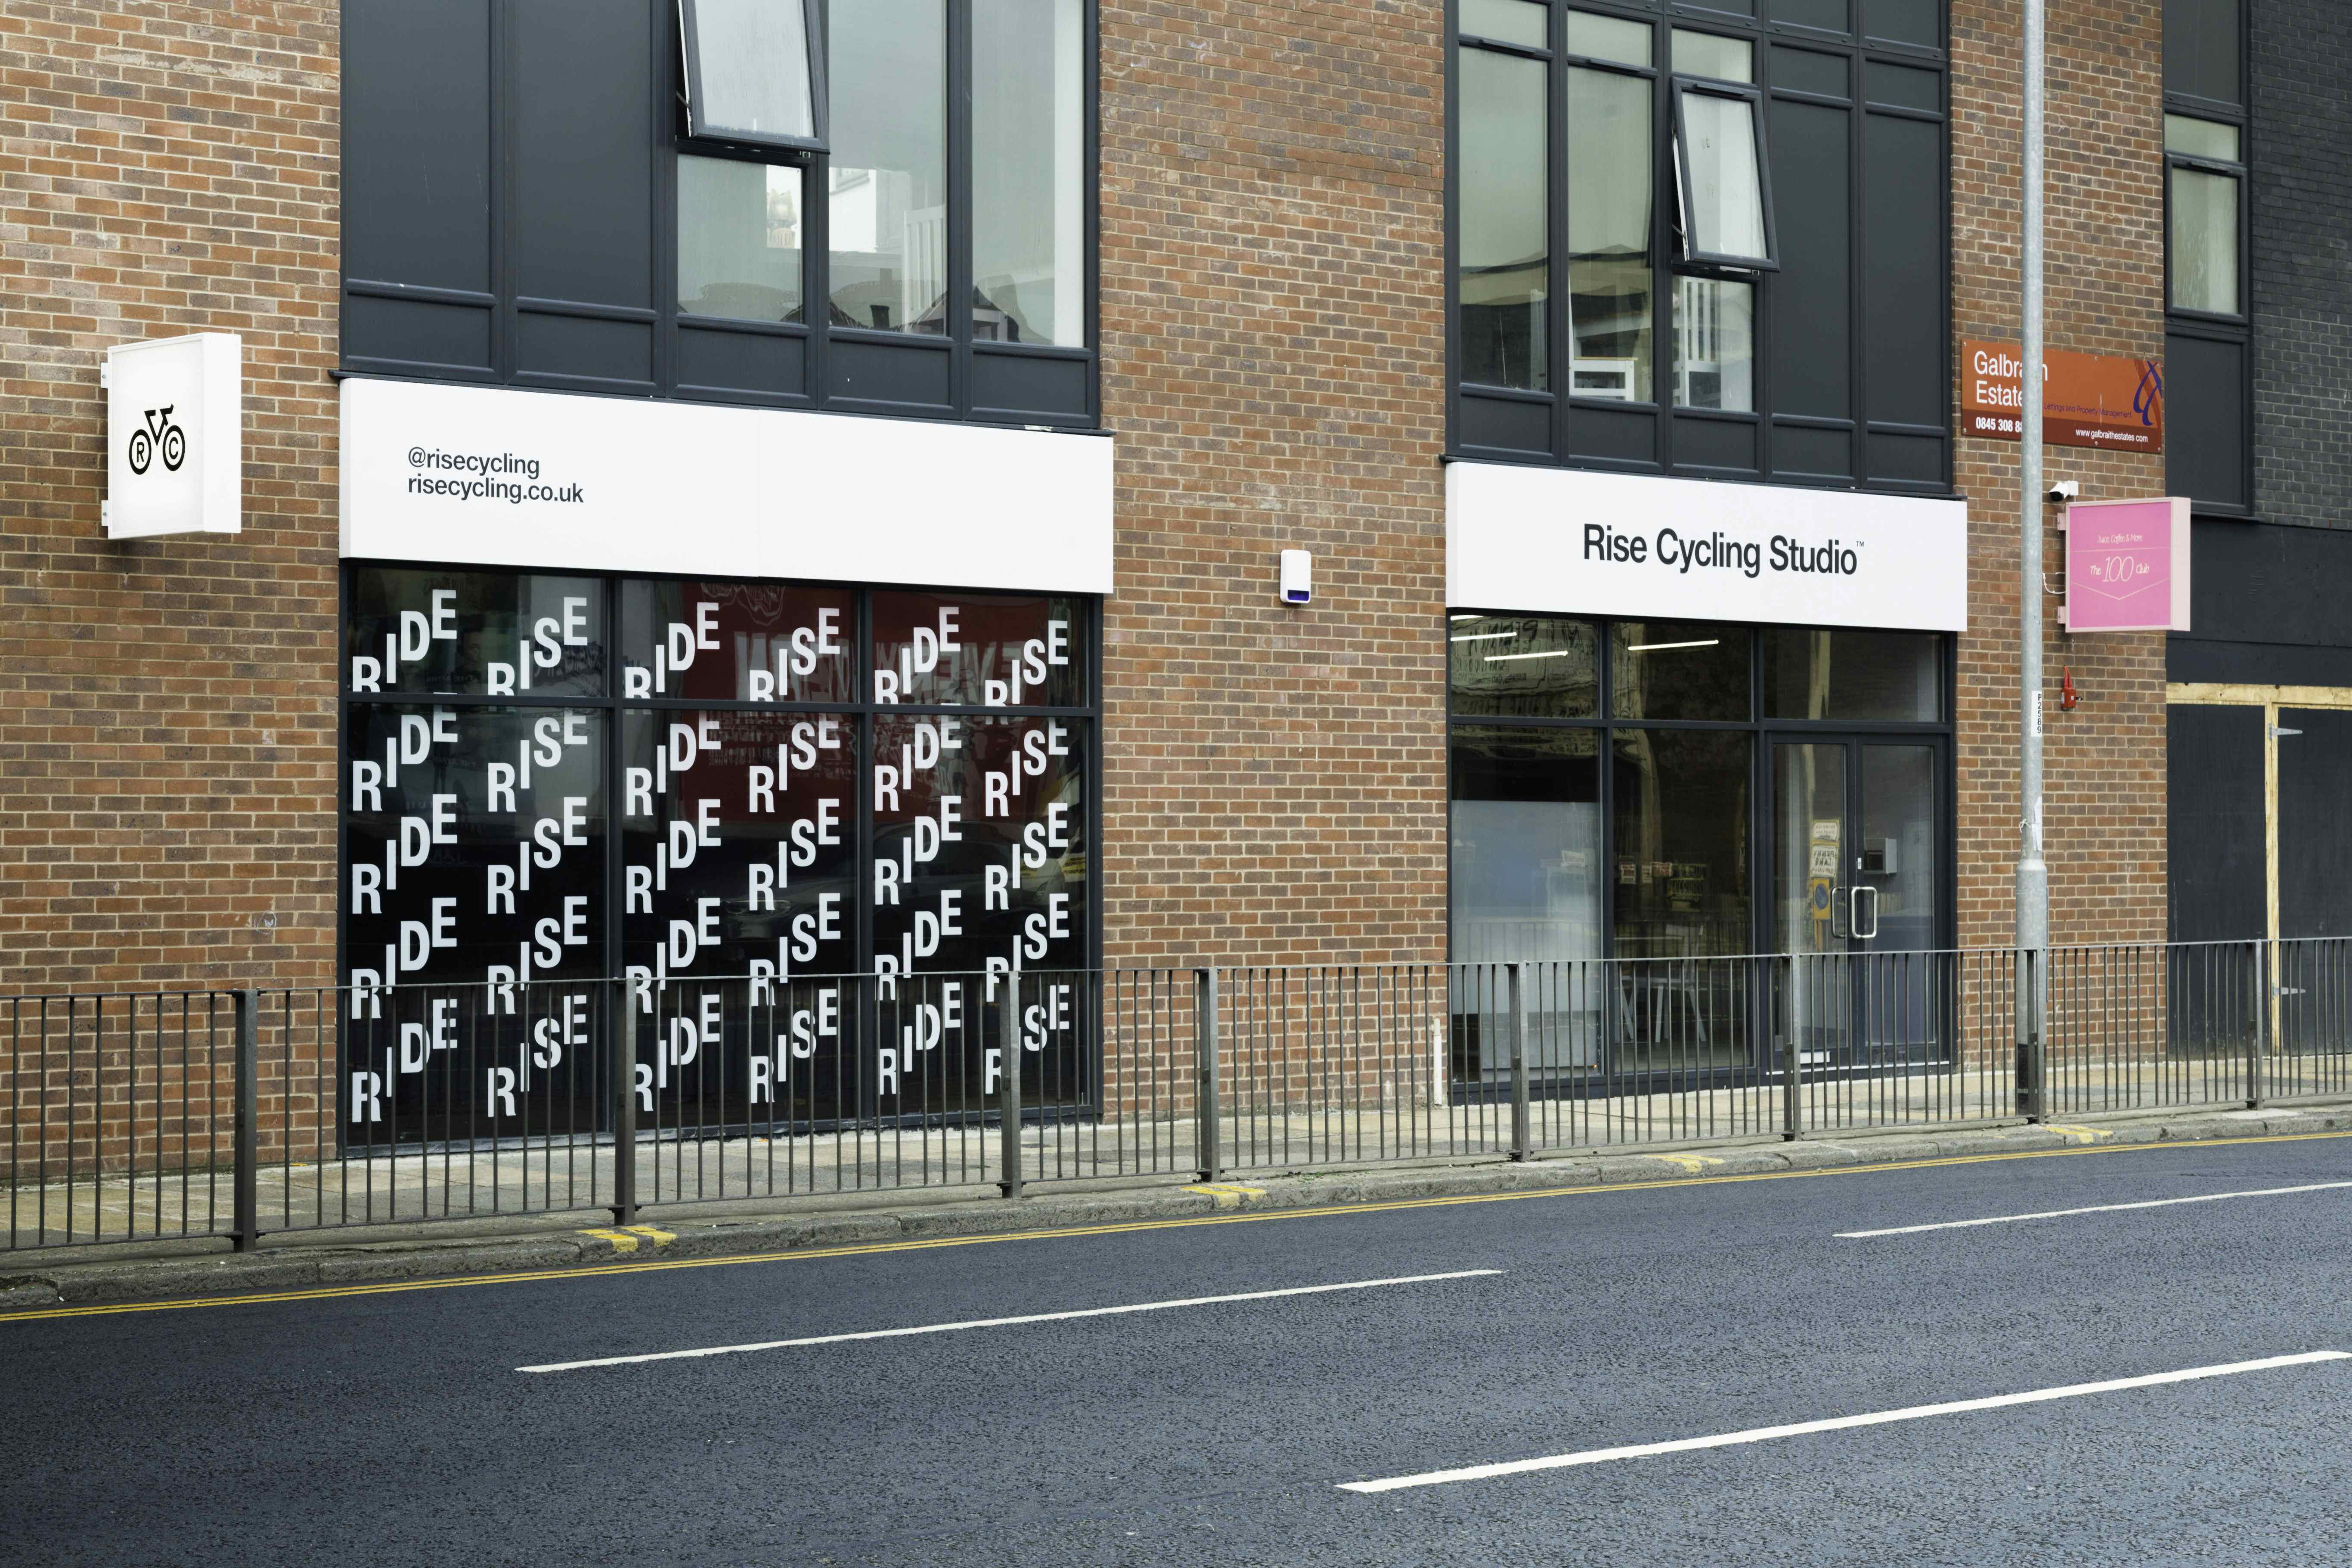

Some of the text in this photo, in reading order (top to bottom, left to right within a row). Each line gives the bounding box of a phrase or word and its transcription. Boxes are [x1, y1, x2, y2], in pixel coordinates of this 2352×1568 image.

[1974, 350, 2048, 381] Galbr
[1977, 380, 2022, 407] Estat
[1976, 416, 1996, 430] 0845
[1998, 418, 2013, 432] 308
[2044, 403, 2064, 412] Lettings
[2077, 406, 2098, 415] Property
[2099, 408, 2132, 418] Management
[408, 446, 539, 479] @risecycling
[408, 474, 584, 504] risecycling.co.uk
[1584, 523, 1647, 563] Rise
[1656, 528, 1760, 578] Cycling
[2090, 556, 2150, 582] The 100 Club
[353, 589, 457, 705] RIDE
[488, 597, 588, 711] RISE
[625, 602, 720, 714] RIDE
[750, 607, 840, 716] RISE
[875, 607, 961, 715] RIDE
[985, 620, 1068, 725] RISE
[353, 693, 458, 811] RIDE
[488, 696, 588, 812] RISE
[626, 711, 721, 815] RIDE
[749, 713, 840, 812] RISE
[875, 703, 961, 811] RIDE
[985, 718, 1069, 817] RISE
[352, 794, 1069, 914] RIDE RISE RIDE RISE RIDE RISE
[352, 897, 457, 1019] RIDE
[488, 896, 588, 1014] RISE
[626, 898, 721, 1013] RIDE
[750, 893, 841, 1006] RISE
[875, 890, 962, 1001] RIDE
[352, 999, 458, 1122] RIDE
[488, 995, 588, 1117] RISE
[751, 989, 837, 1103] RISE
[880, 982, 961, 1095] RIDE
